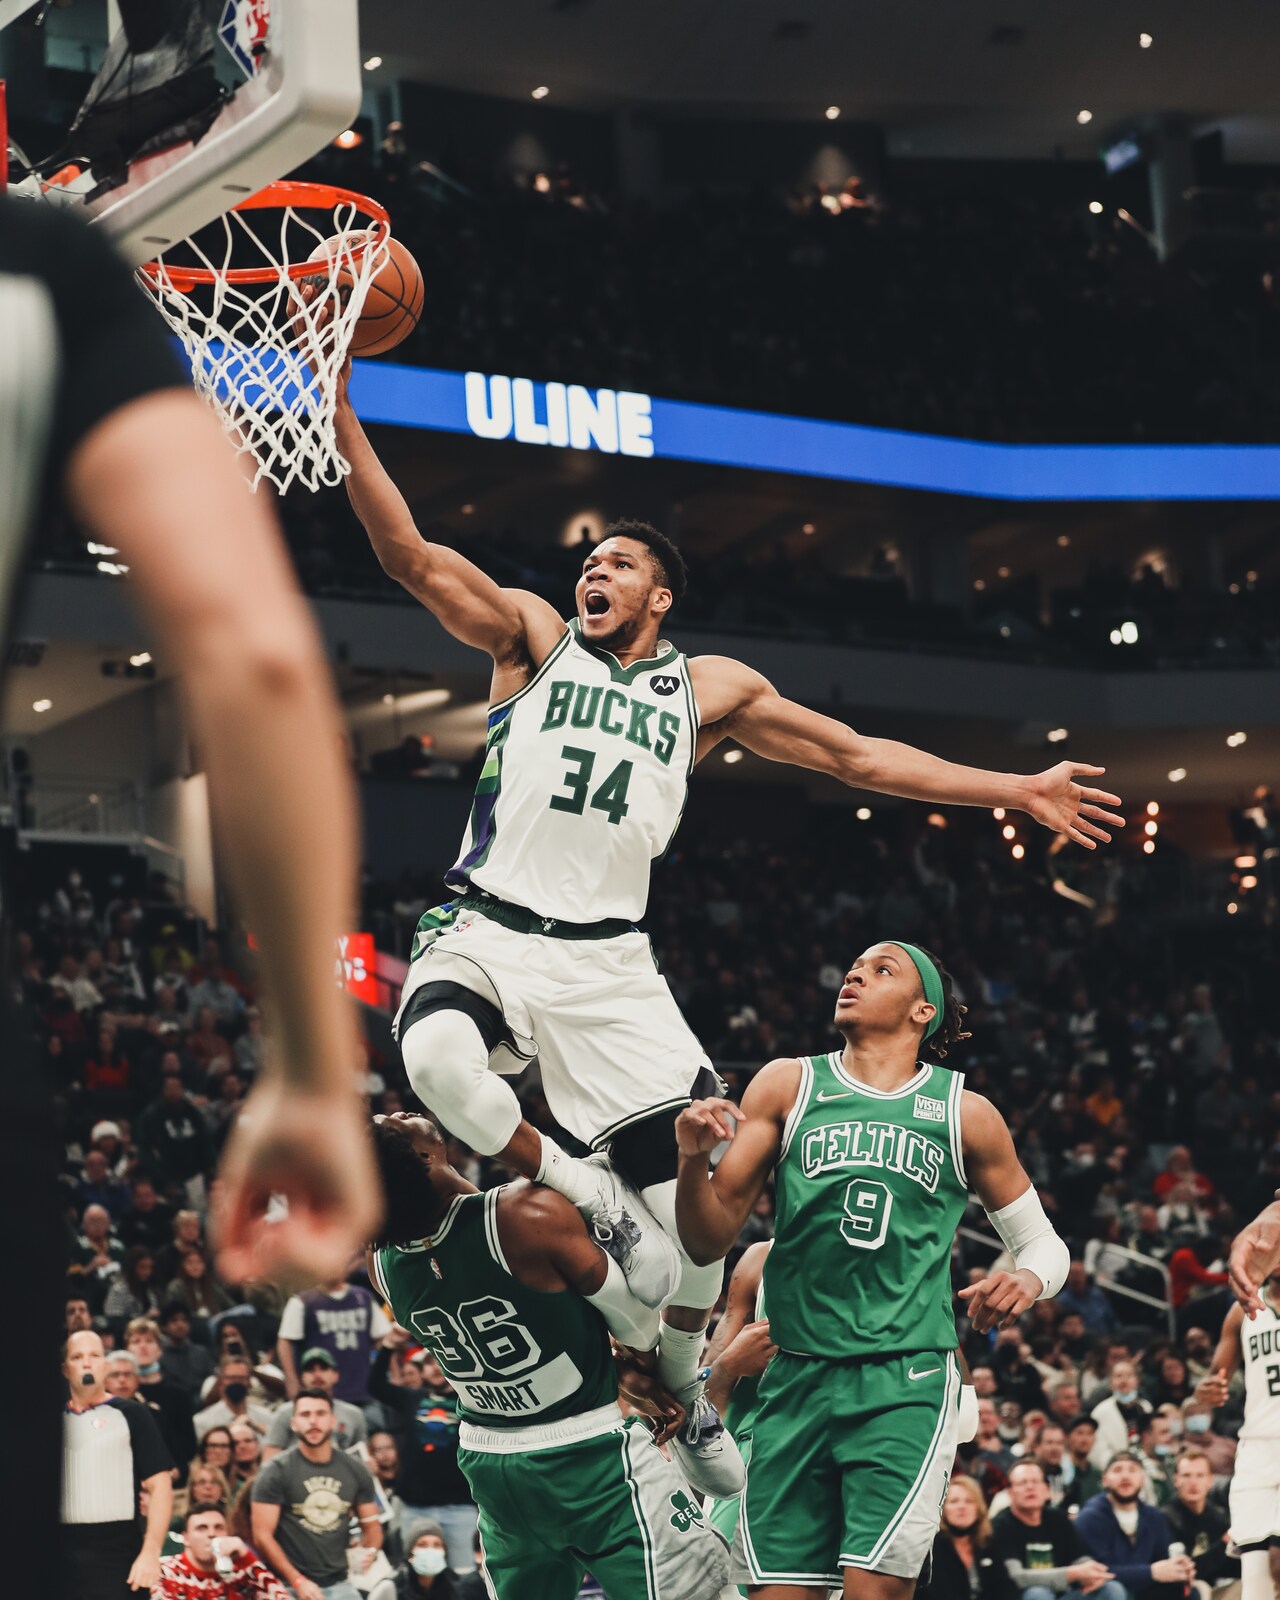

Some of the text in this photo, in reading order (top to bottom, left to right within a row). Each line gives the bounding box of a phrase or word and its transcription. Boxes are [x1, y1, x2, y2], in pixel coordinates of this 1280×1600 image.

[464, 371, 654, 458] ULINE
[539, 680, 681, 767] BUCKS
[549, 744, 634, 825] 34
[917, 1096, 943, 1112] VISTA
[801, 1121, 944, 1194] CELTICS
[839, 1178, 893, 1250] 9
[410, 1295, 542, 1378] 36
[465, 1378, 541, 1412] SMART
[677, 1503, 698, 1524] RED
